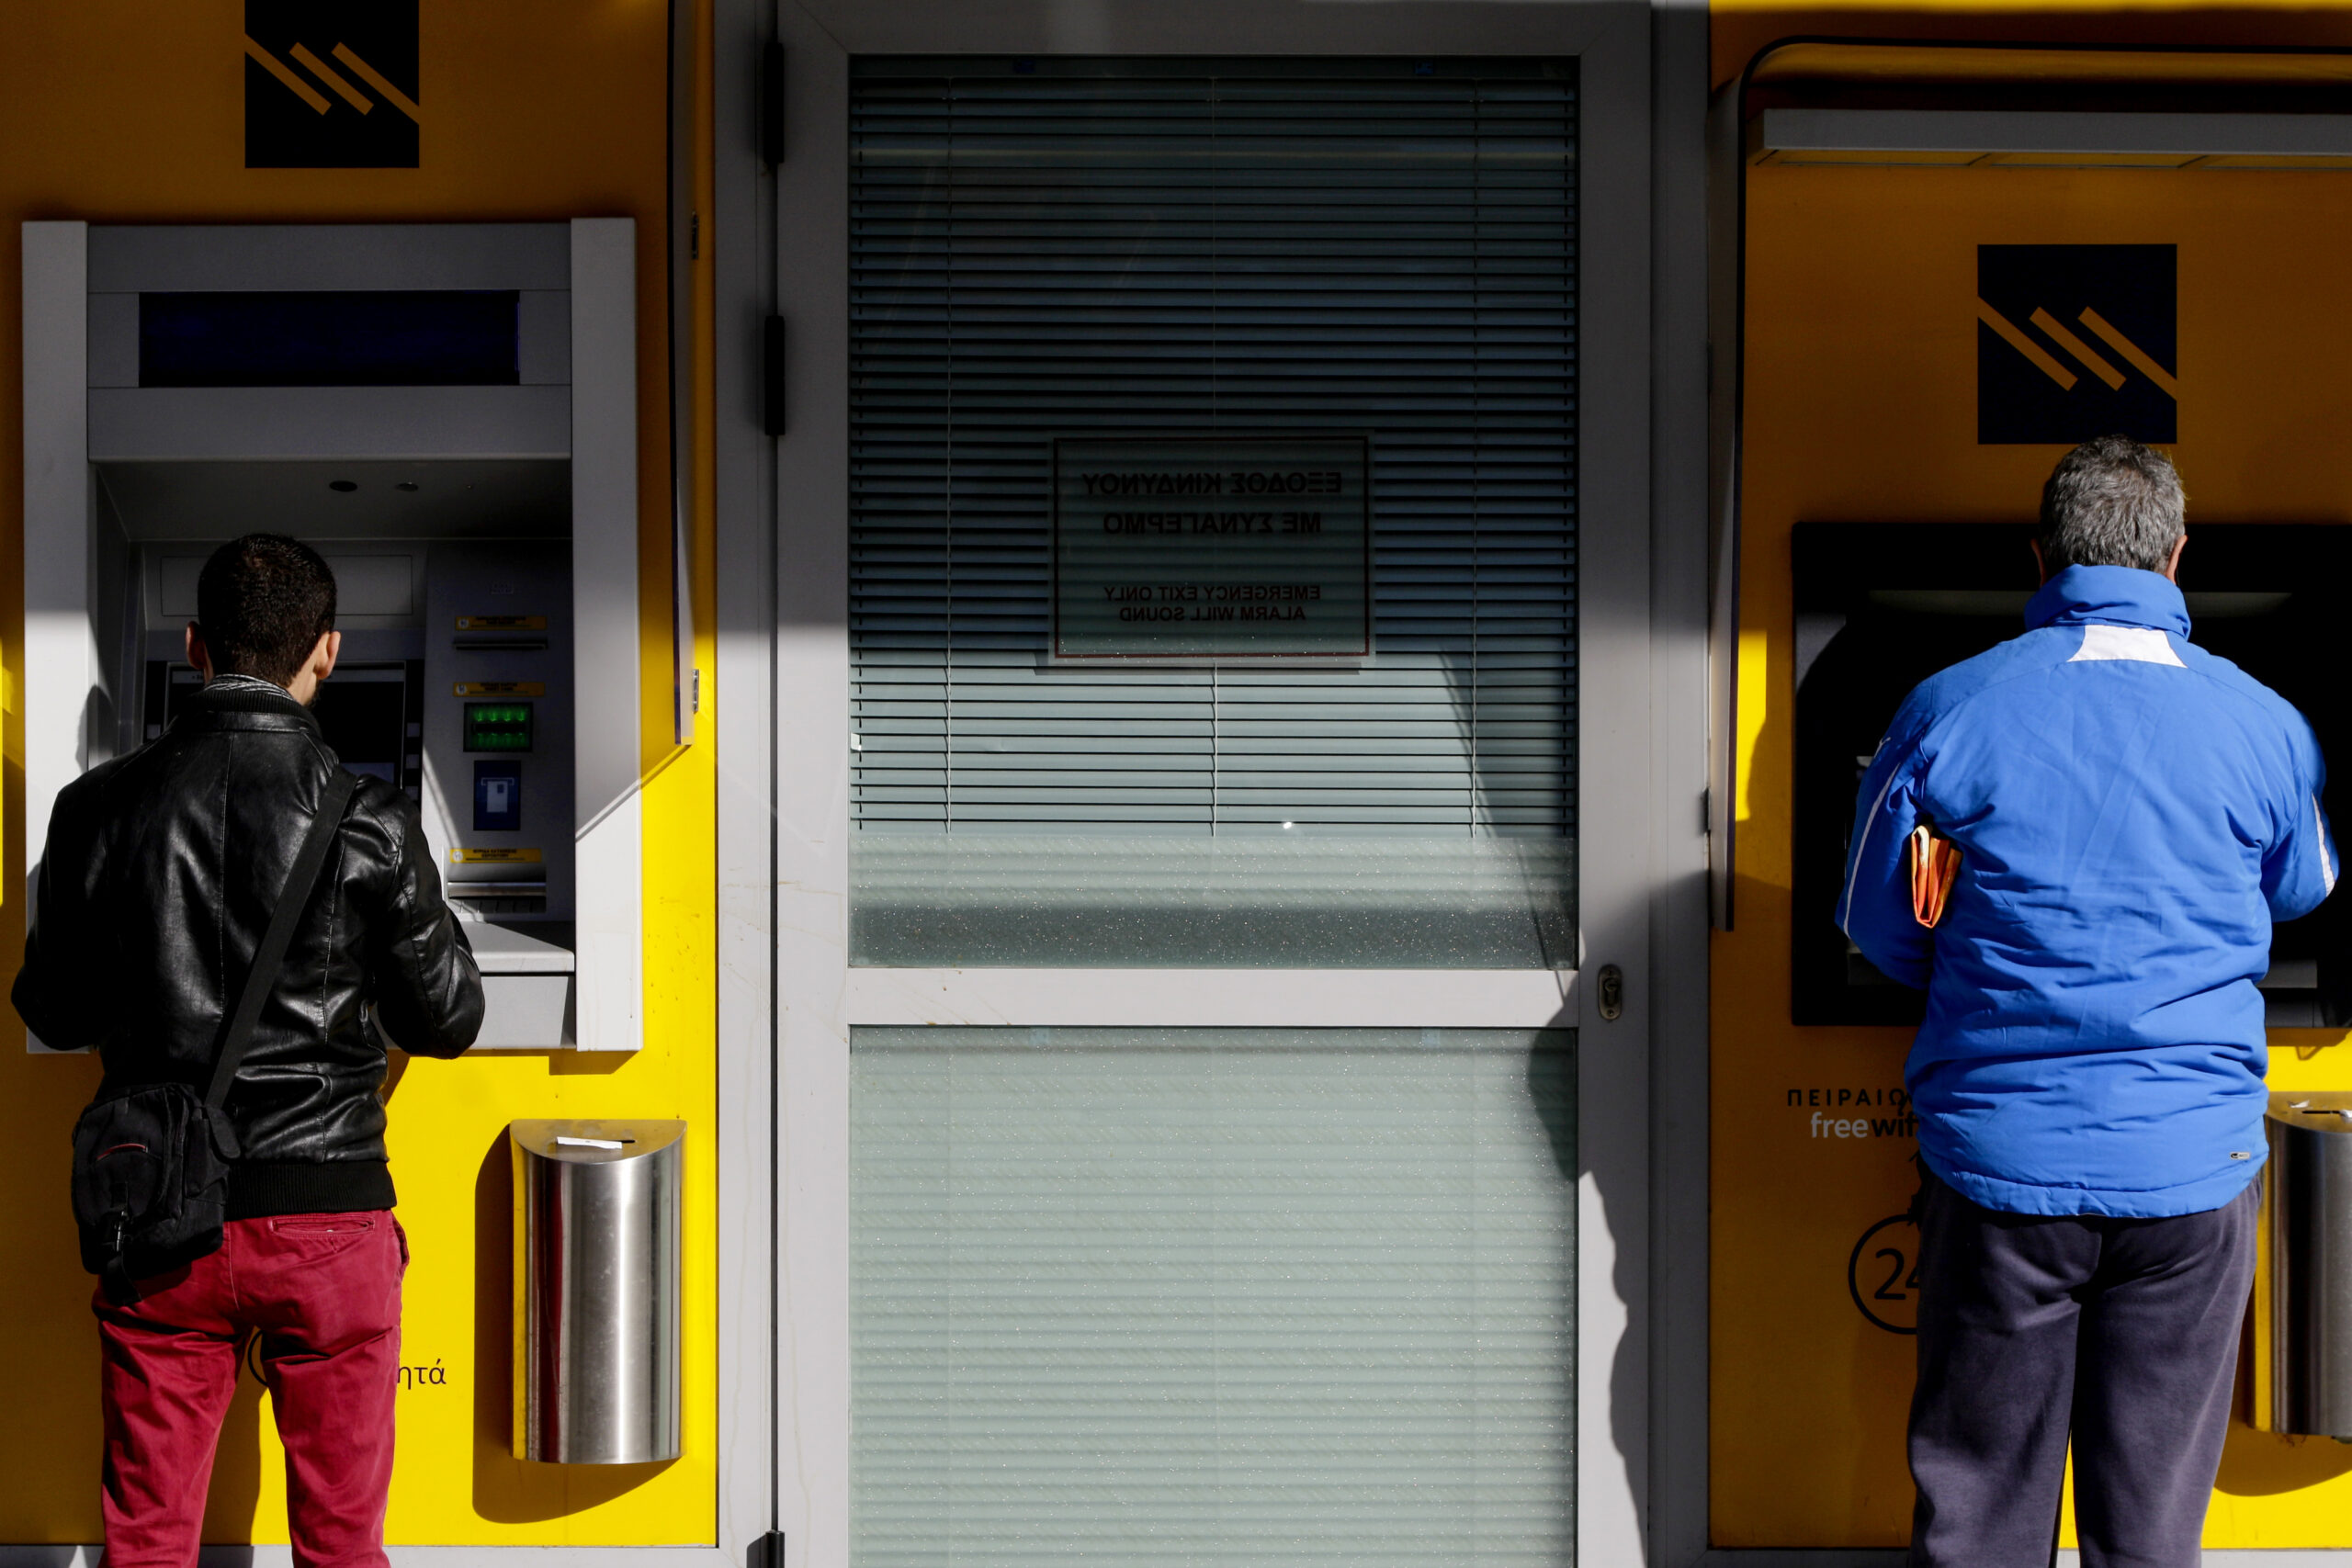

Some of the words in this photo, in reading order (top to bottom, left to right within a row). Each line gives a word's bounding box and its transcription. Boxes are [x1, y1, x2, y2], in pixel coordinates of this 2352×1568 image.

[1787, 1089, 1905, 1106] ΠΕΙΡΑΙΩ
[1871, 1111, 1918, 1137] wif
[397, 1358, 447, 1390] ητά
